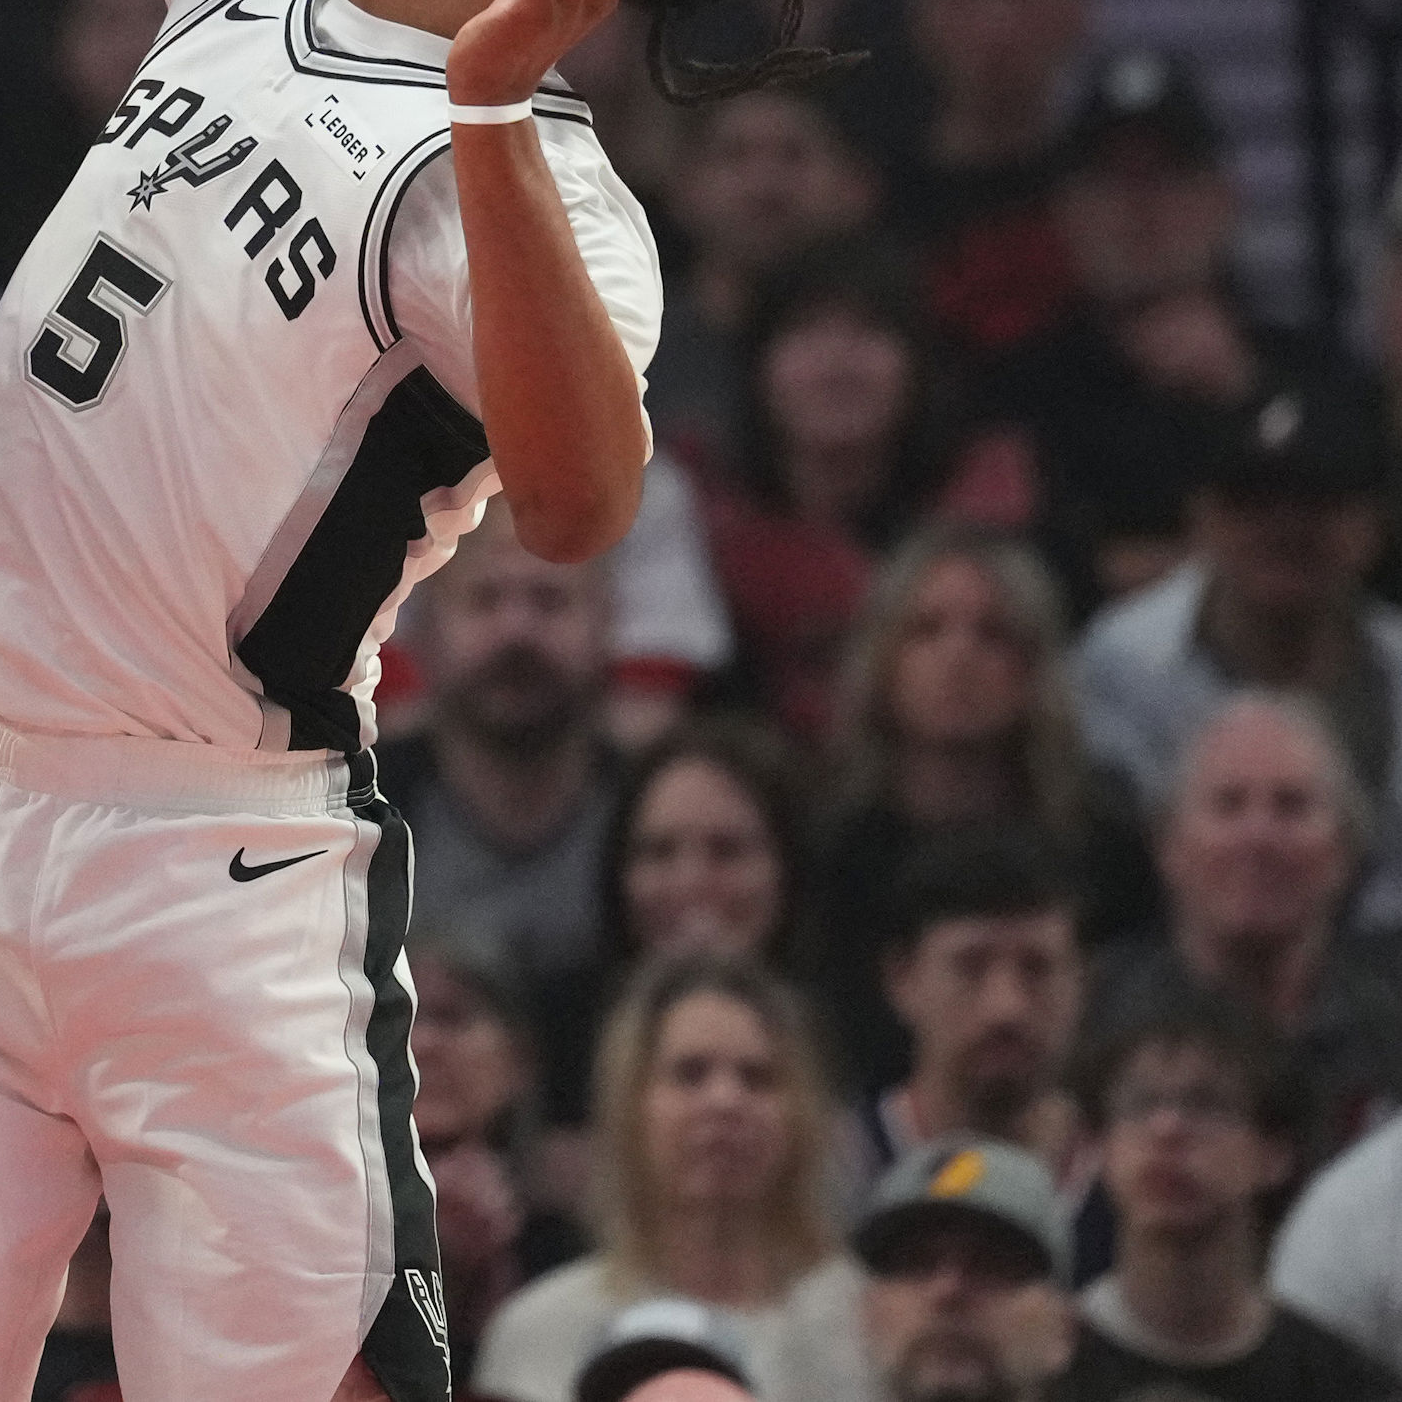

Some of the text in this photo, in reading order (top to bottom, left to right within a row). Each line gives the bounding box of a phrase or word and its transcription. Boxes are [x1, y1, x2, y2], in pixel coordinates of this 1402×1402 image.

[96, 78, 338, 322] SPURS
[319, 109, 369, 164] LEDGER
[24, 231, 174, 414] 5
